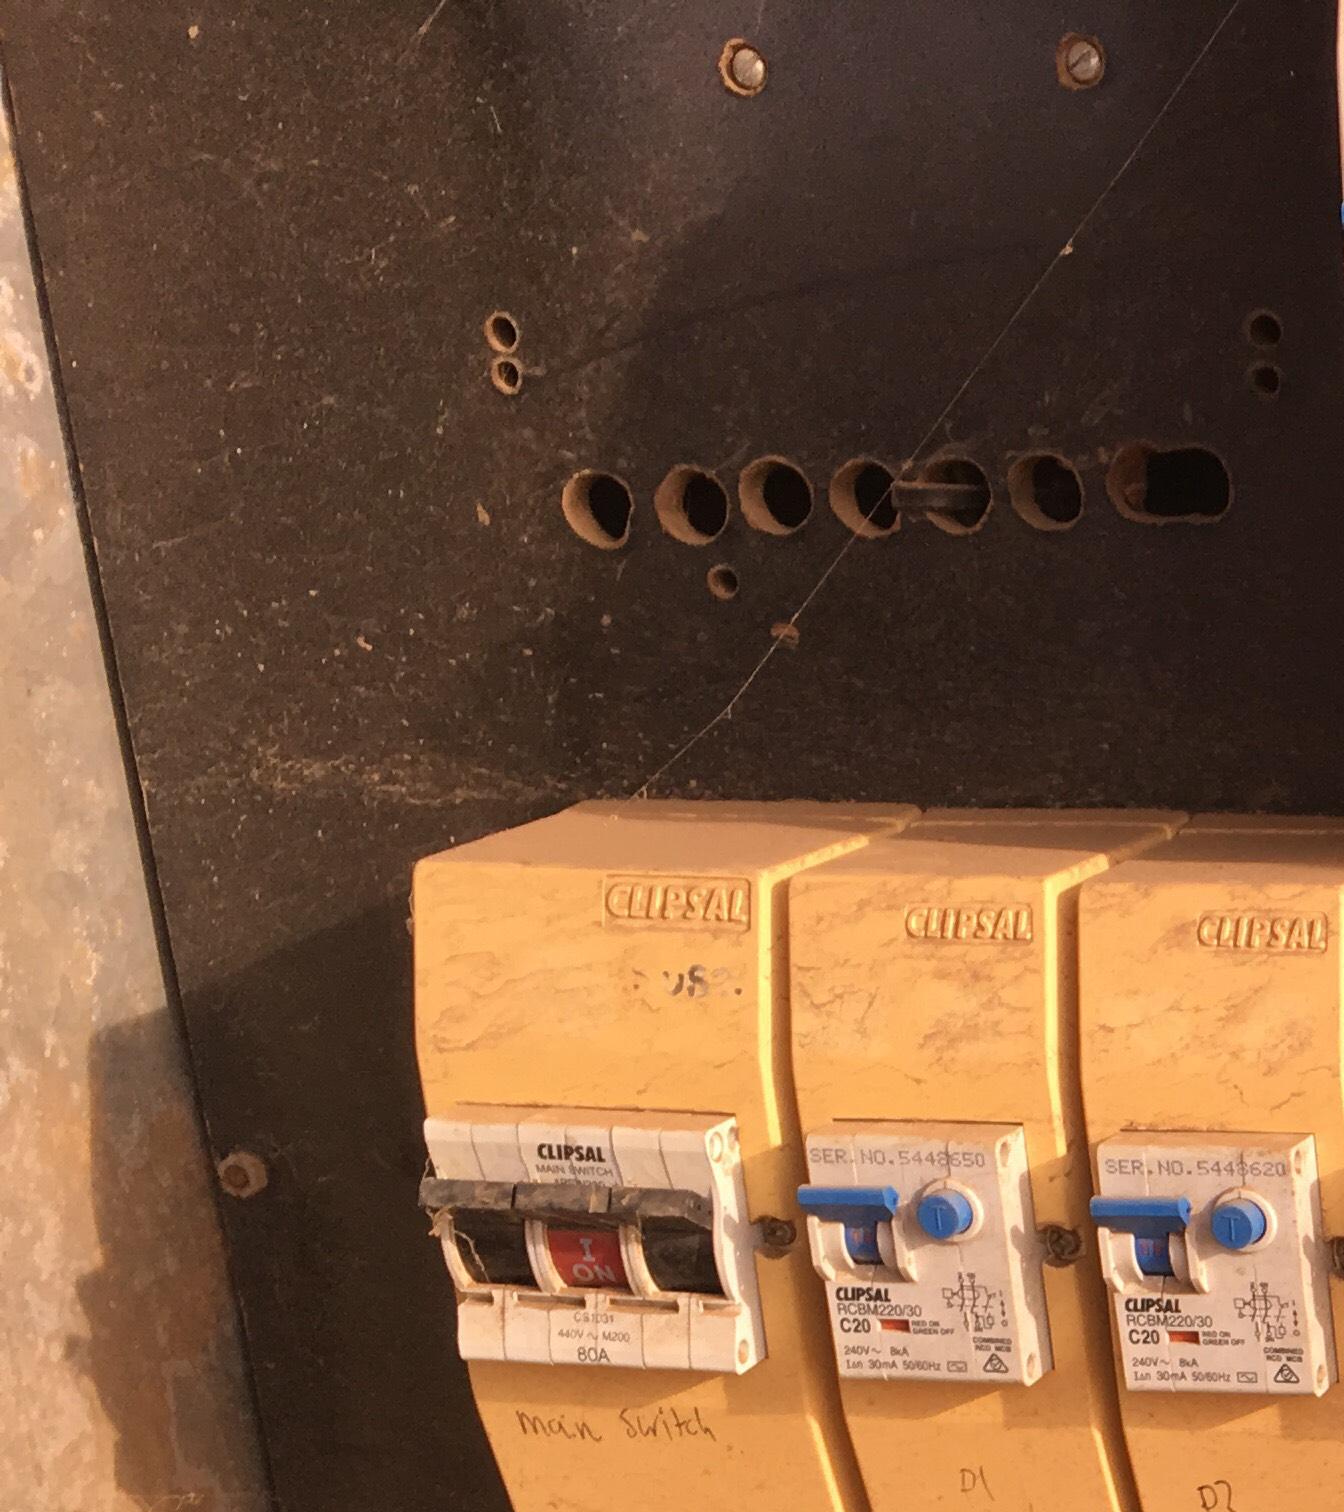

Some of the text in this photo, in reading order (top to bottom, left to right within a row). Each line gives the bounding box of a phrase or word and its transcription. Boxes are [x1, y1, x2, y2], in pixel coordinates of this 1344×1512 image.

[604, 880, 749, 925] CLIPSAL
[904, 905, 1033, 942] CLIPSAL
[1198, 911, 1328, 951] CLIPSAL
[536, 1143, 606, 1163] CLIPSAL
[535, 1164, 614, 1177] MAIN SWITCH
[572, 1263, 617, 1281] ON
[835, 1287, 892, 1302] CLIPSAL
[837, 1302, 922, 1317] RCBM220/30
[1124, 1297, 1182, 1314] CLIPSAL
[840, 1318, 871, 1333] C20
[1127, 1314, 1213, 1328] RCBM220/30
[602, 1331, 631, 1343] M200
[1128, 1329, 1160, 1344] C20
[577, 1346, 611, 1363] 80A
[868, 1359, 897, 1370] 30mA
[1156, 1371, 1187, 1381] 30mA
